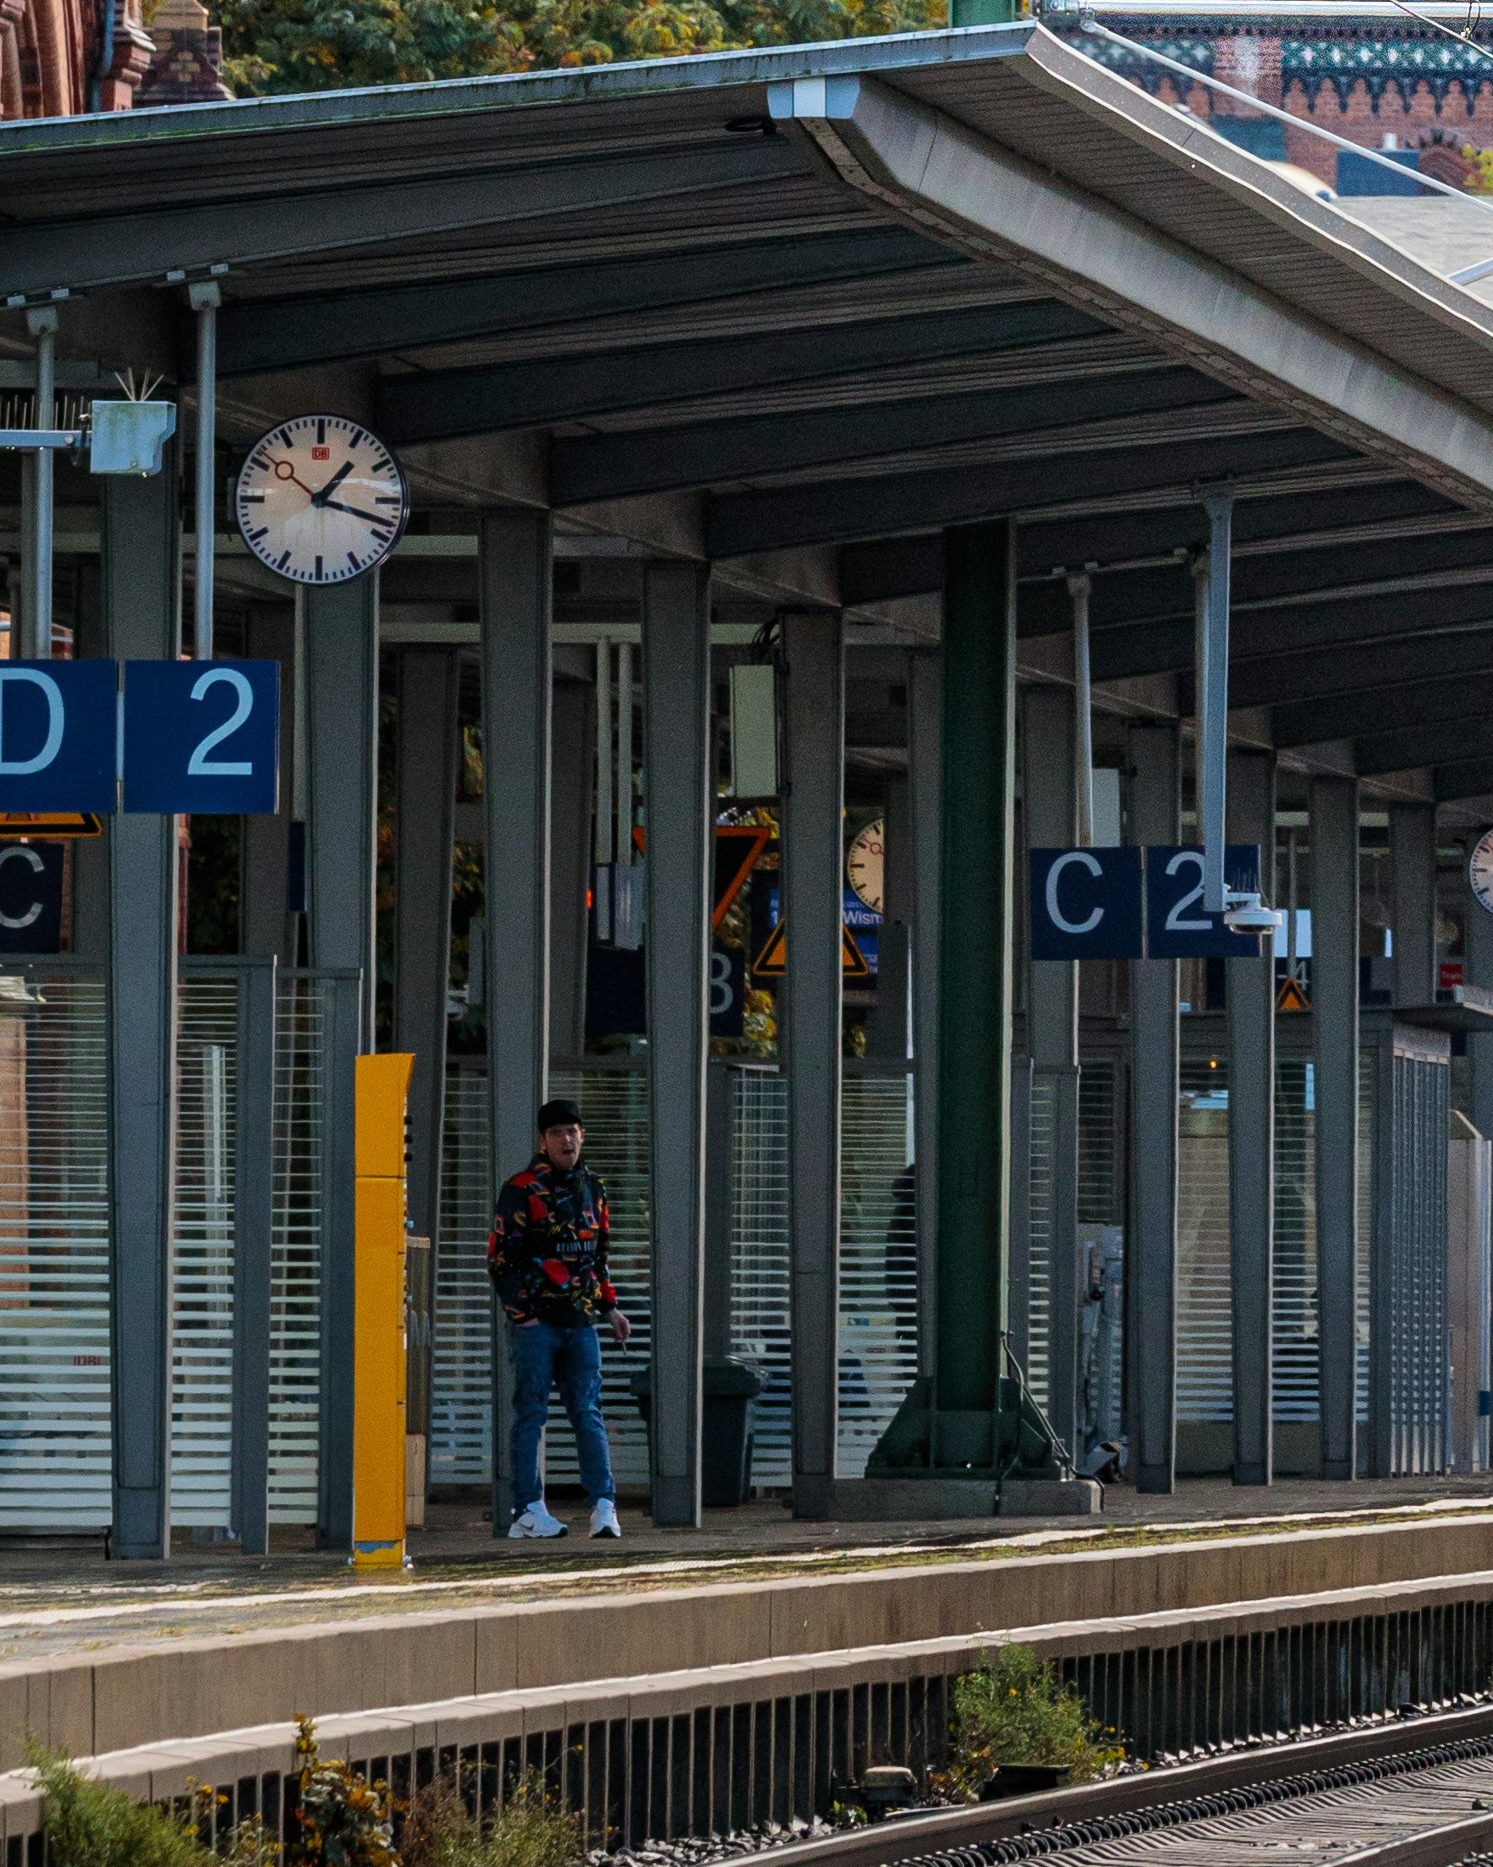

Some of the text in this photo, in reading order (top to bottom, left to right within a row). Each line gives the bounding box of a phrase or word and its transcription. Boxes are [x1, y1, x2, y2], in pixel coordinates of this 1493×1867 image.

[187, 668, 254, 776] 2
[1045, 851, 1213, 934] C 2
